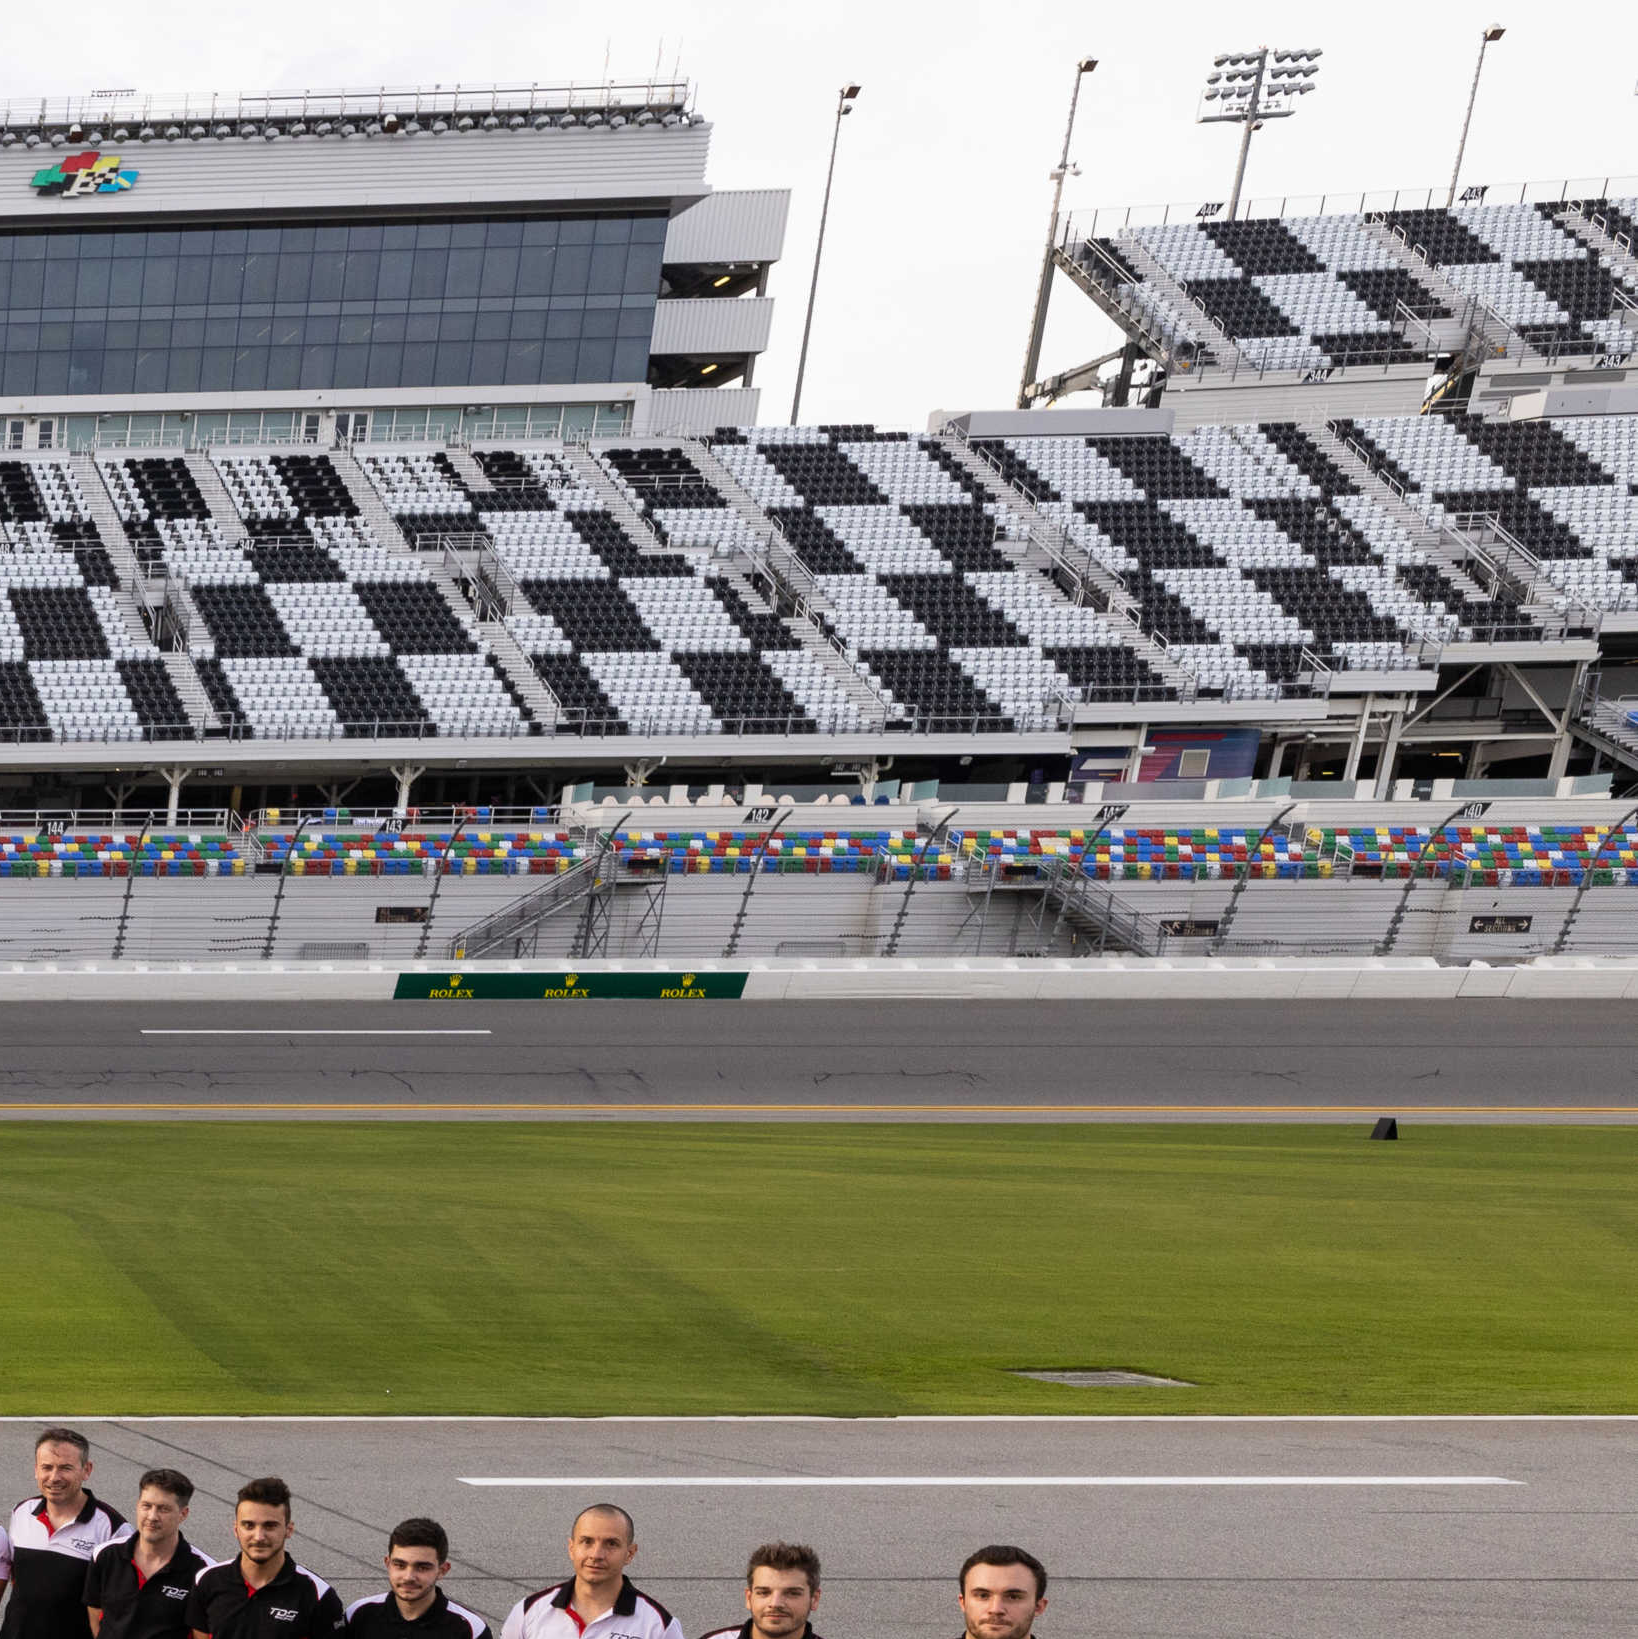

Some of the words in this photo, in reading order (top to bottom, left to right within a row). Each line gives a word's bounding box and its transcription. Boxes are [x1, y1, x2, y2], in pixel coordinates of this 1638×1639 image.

[1601, 355, 1621, 367] 343
[1310, 370, 1328, 380] 344
[239, 540, 255, 550] 347
[751, 808, 769, 822] 142
[1463, 803, 1483, 818] 140
[47, 821, 64, 835] 144
[384, 820, 402, 834] 143
[429, 989, 474, 999] ROLEX
[544, 989, 589, 999] ROLEX
[660, 989, 706, 999] ROLEX
[270, 1607, 298, 1618] TDS
